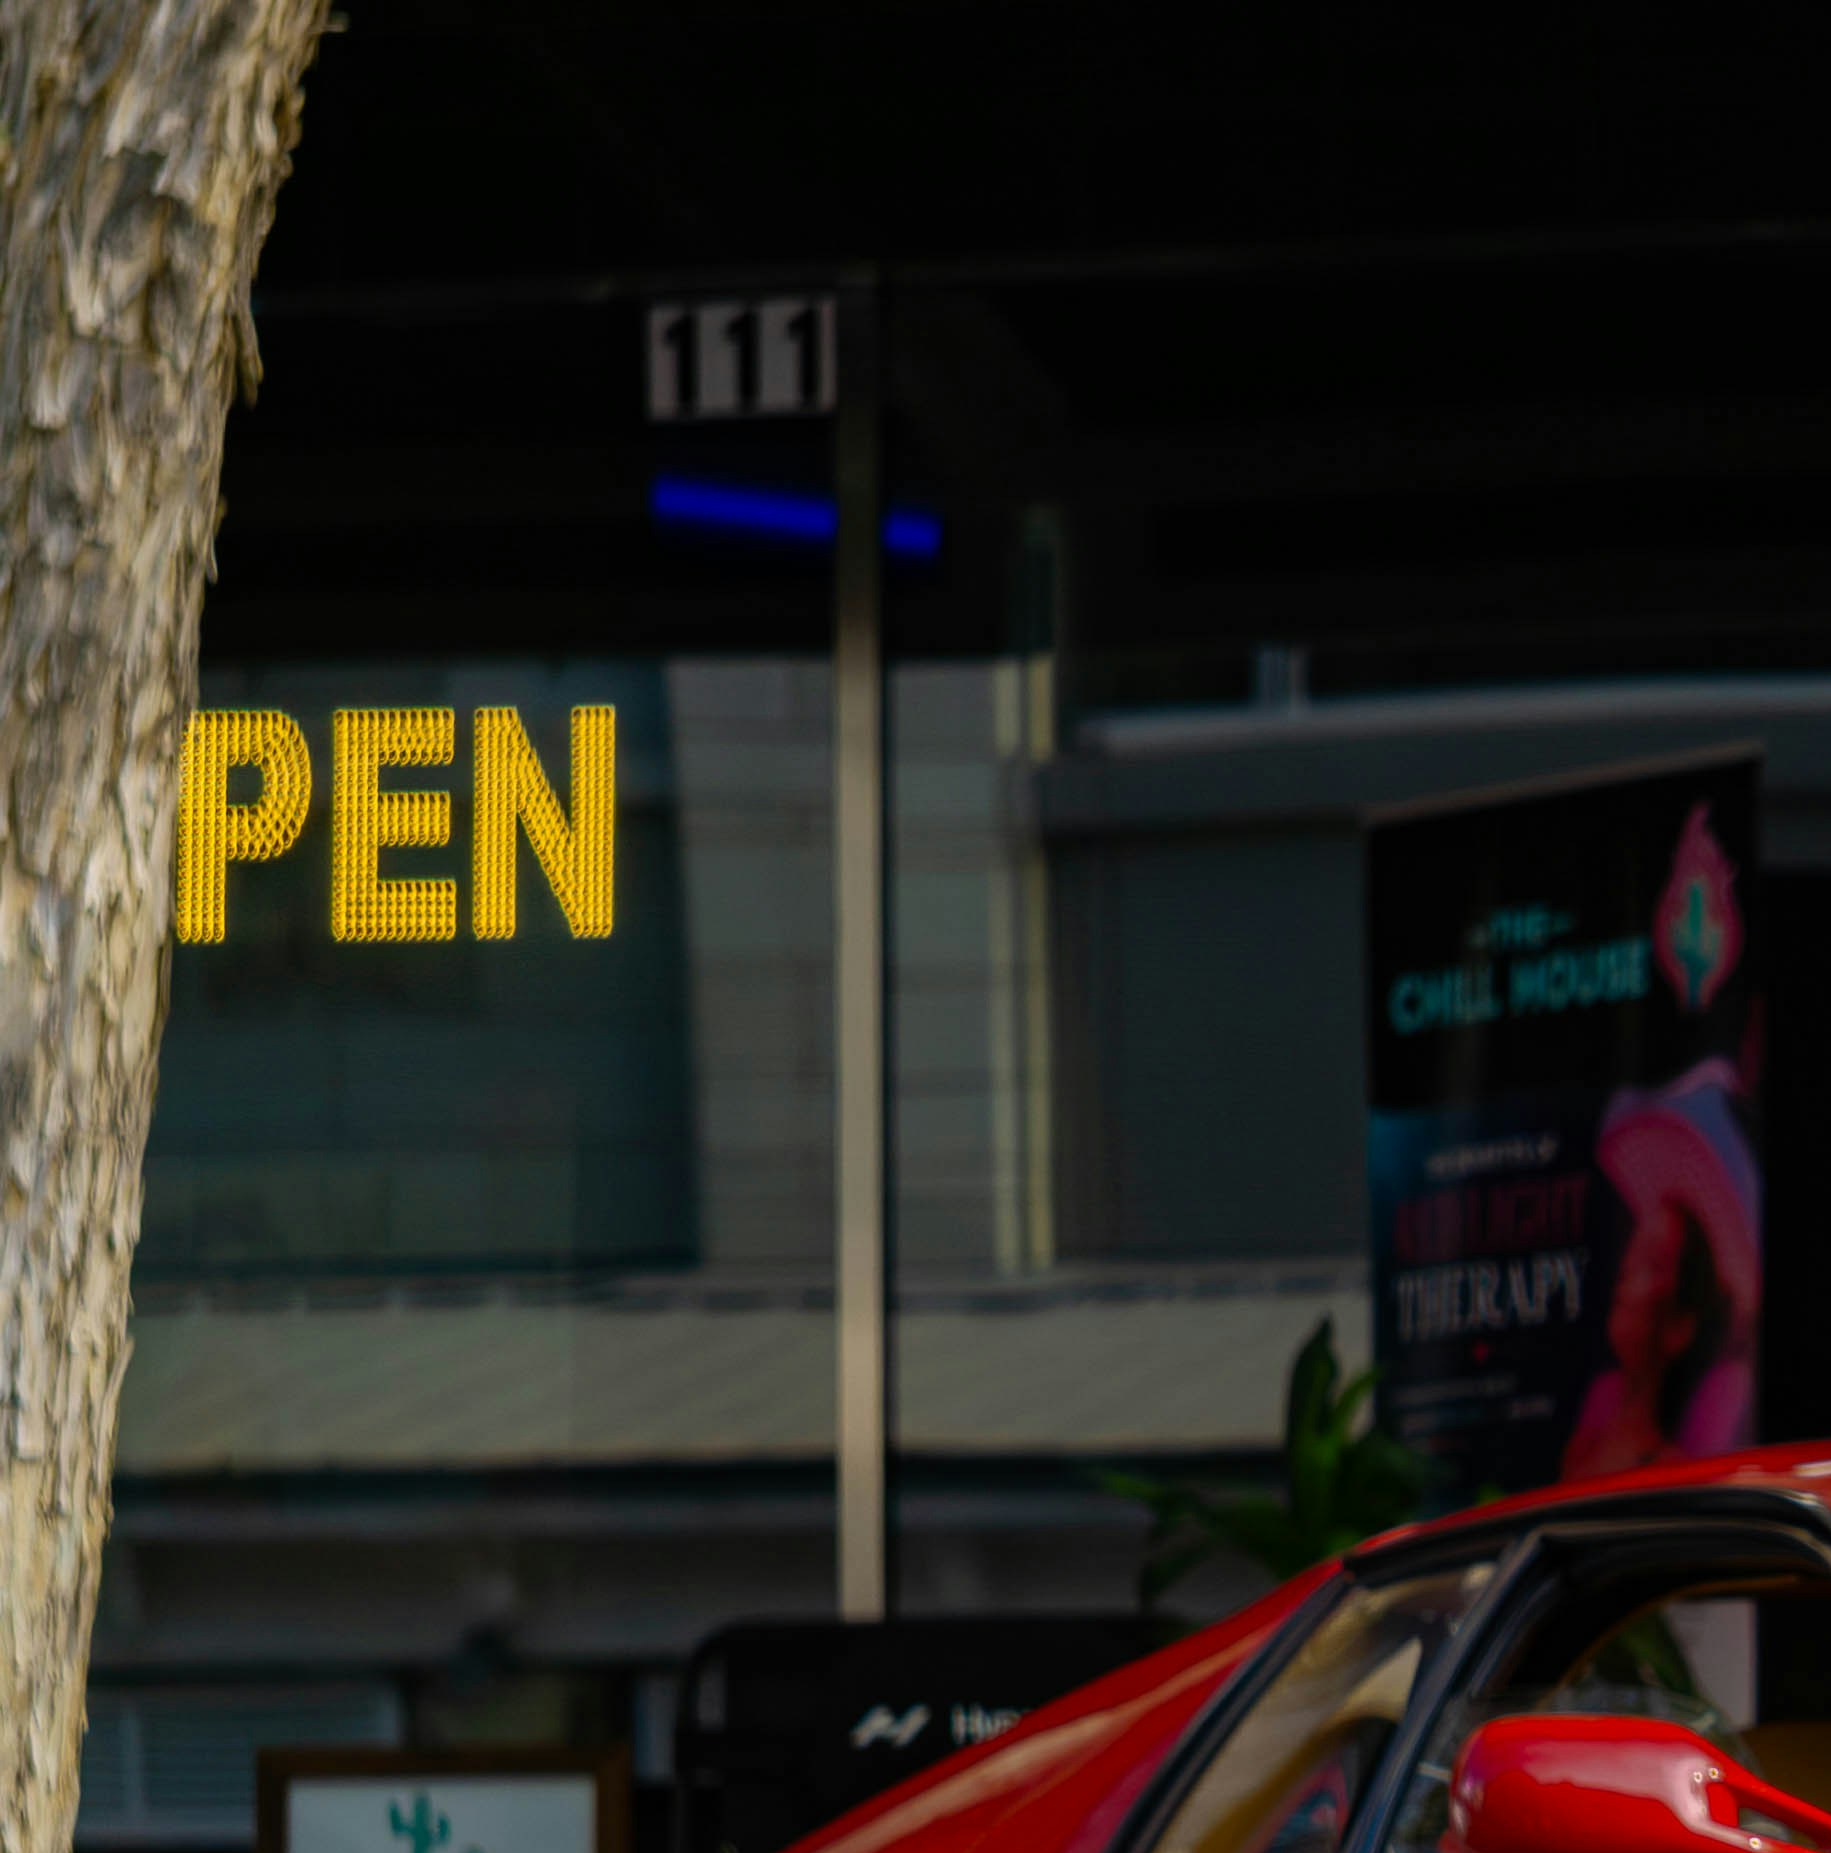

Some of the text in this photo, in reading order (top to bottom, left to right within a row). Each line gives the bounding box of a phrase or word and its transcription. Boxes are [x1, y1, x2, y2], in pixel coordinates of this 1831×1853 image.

[662, 308, 818, 414] 111
[177, 705, 617, 943] PEN
[1389, 934, 1651, 1037] CHILL HOUSE
[1396, 1249, 1584, 1344] THERAPY
